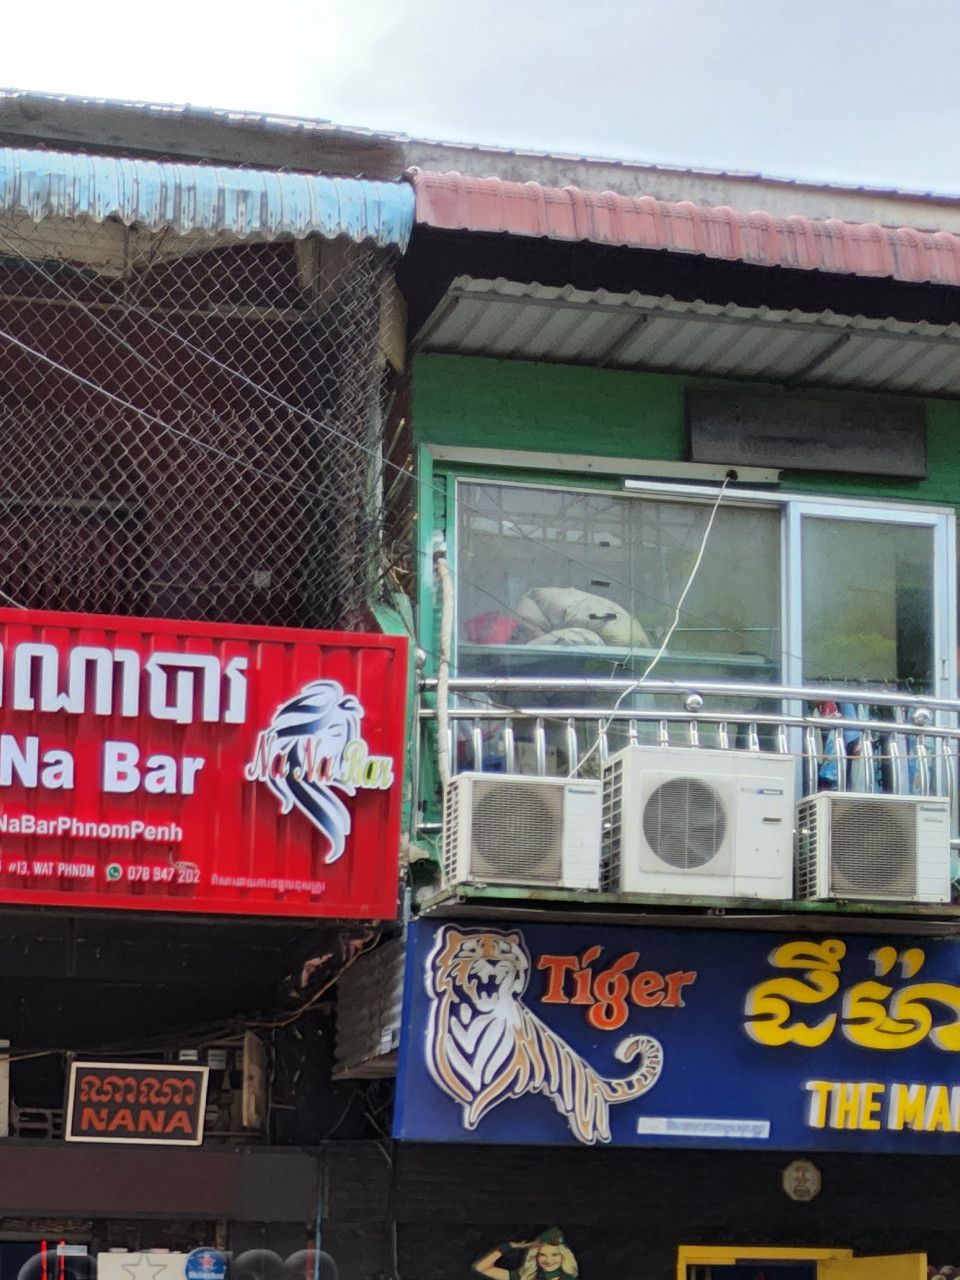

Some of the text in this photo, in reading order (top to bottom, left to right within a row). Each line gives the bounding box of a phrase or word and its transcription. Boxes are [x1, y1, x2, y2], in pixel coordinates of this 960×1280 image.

[103, 740, 205, 795] Bar
[33, 862, 53, 876] WAT
[57, 862, 95, 878] PHNOM
[127, 866, 200, 883] 078 947 202
[540, 944, 696, 1031] Tiger
[81, 1106, 193, 1134] NANA
[805, 1080, 885, 1130] THE
[888, 1082, 960, 1132] MA
